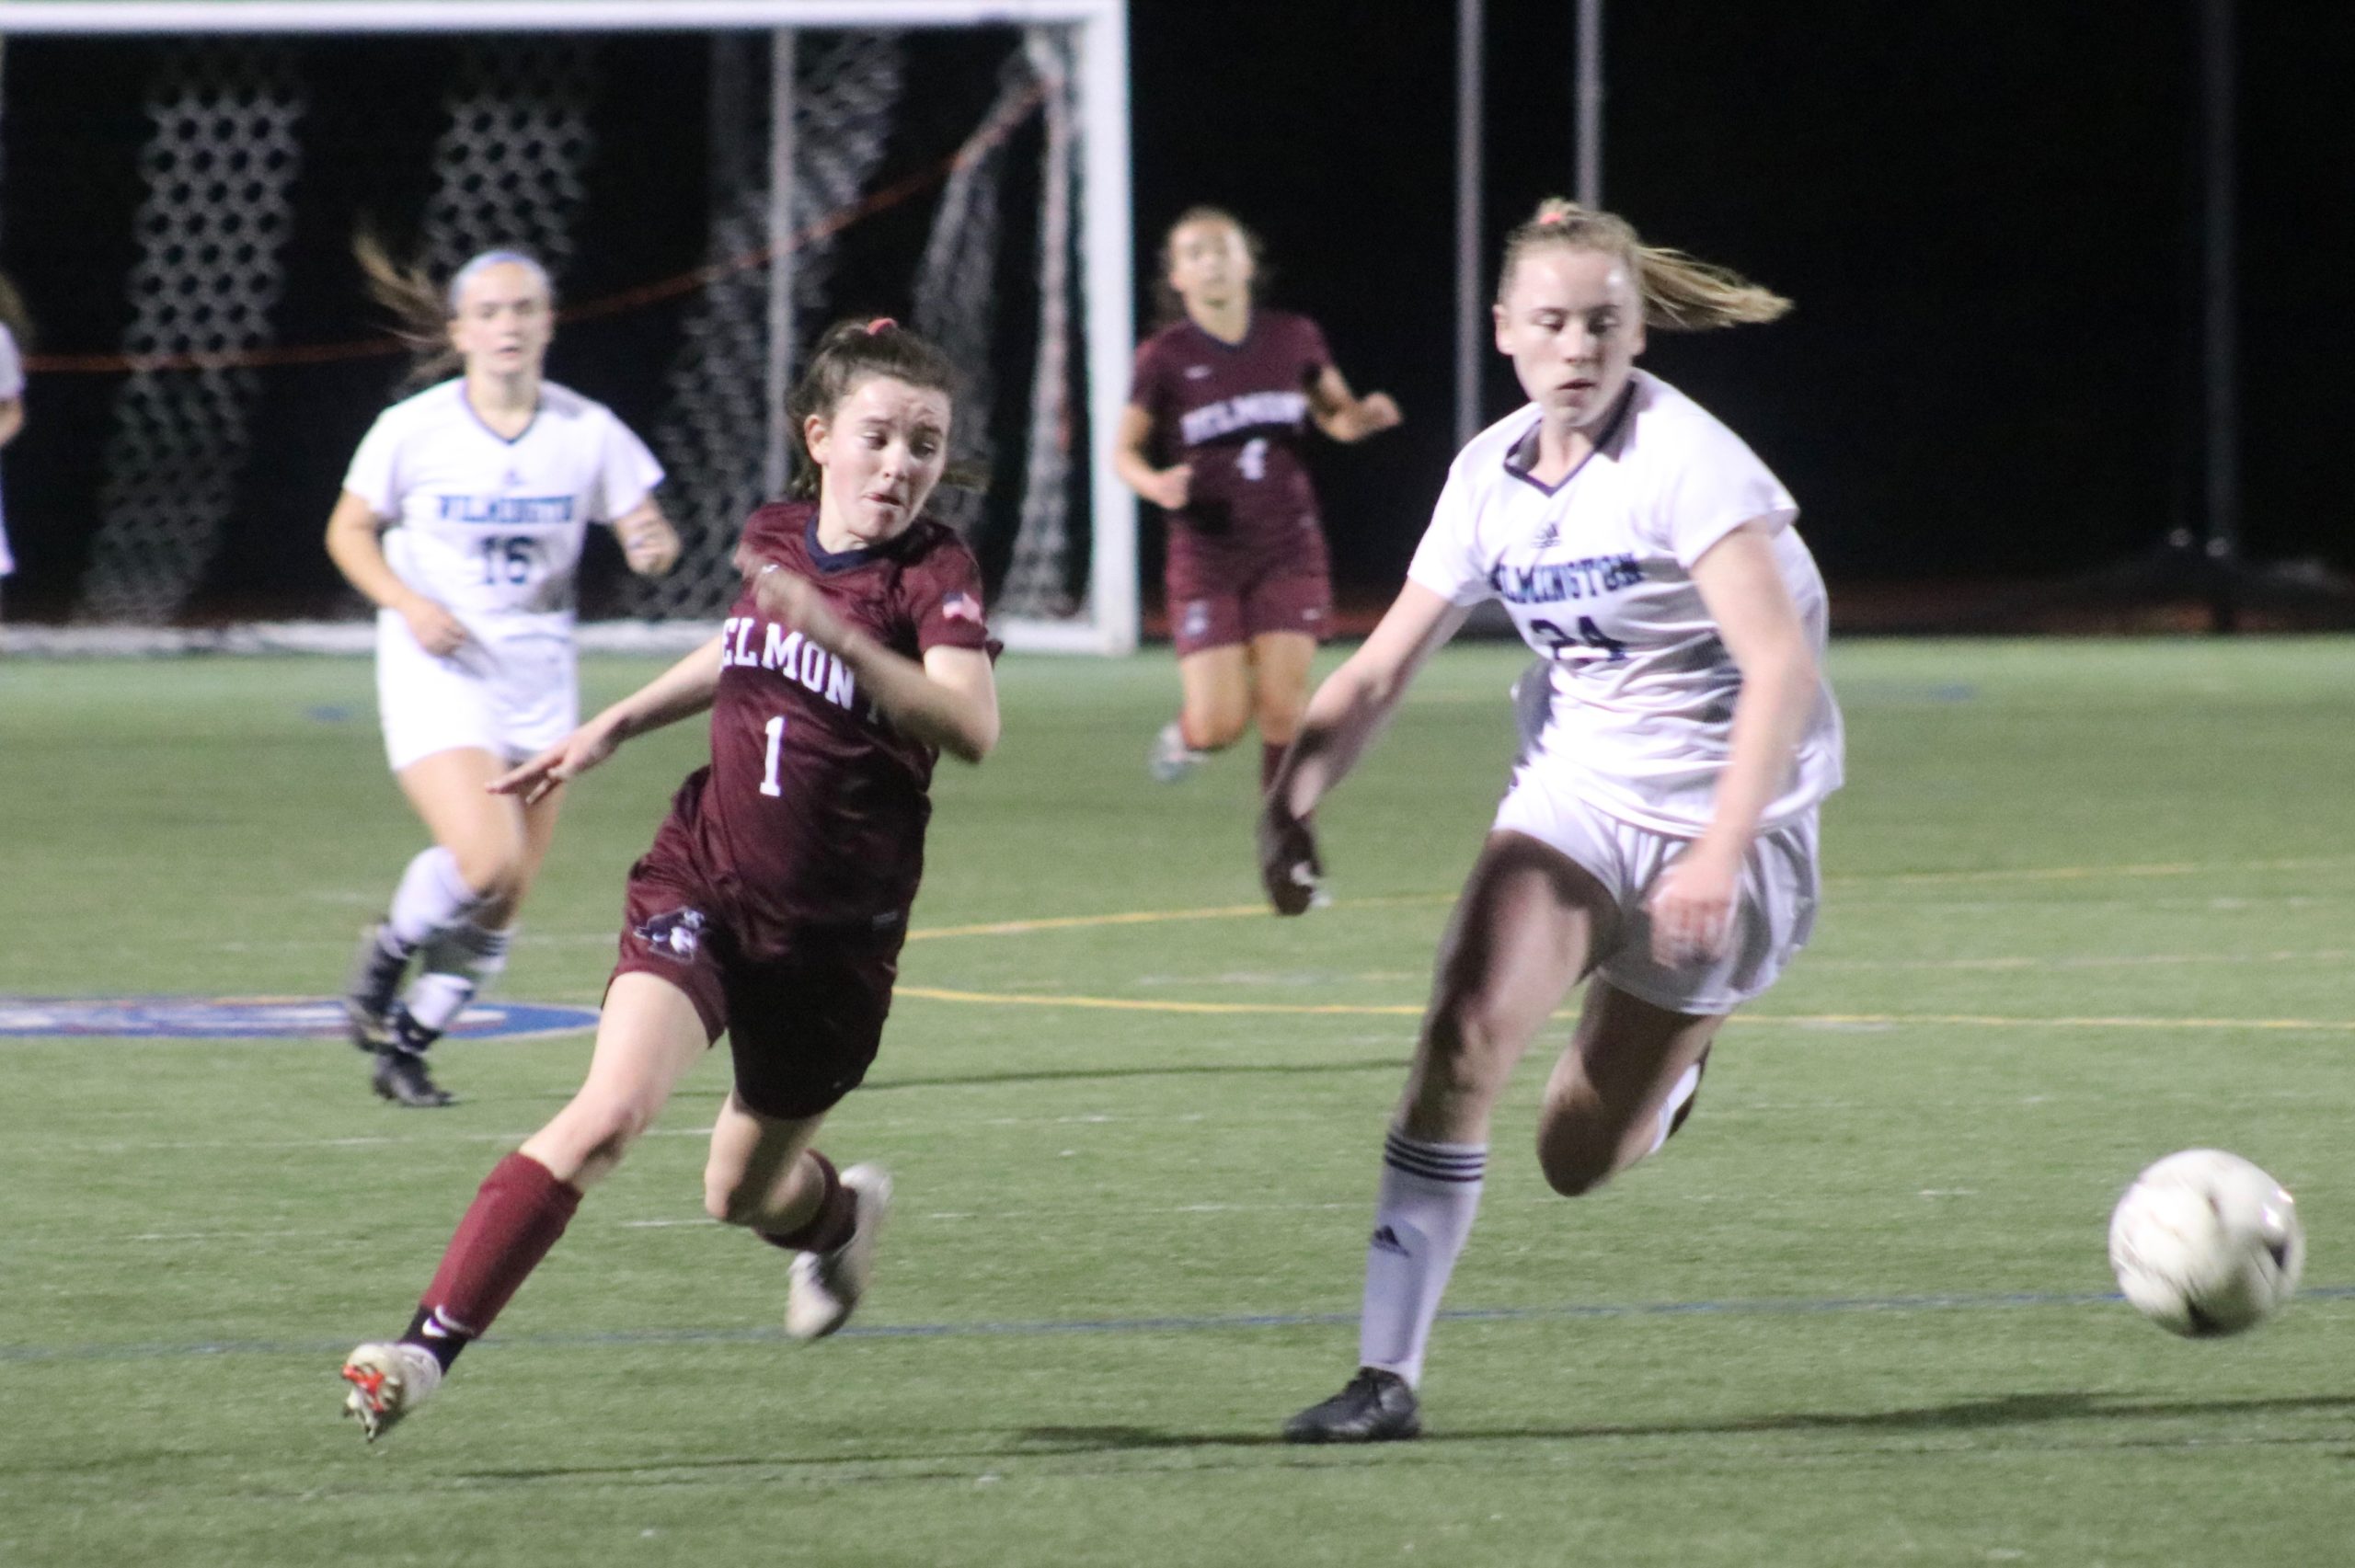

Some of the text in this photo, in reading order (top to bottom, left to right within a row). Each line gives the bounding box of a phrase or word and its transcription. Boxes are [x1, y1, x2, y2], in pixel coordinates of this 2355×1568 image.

[721, 617, 879, 724] ELMON
[1529, 615, 1627, 662] 24
[760, 715, 785, 797] 1
